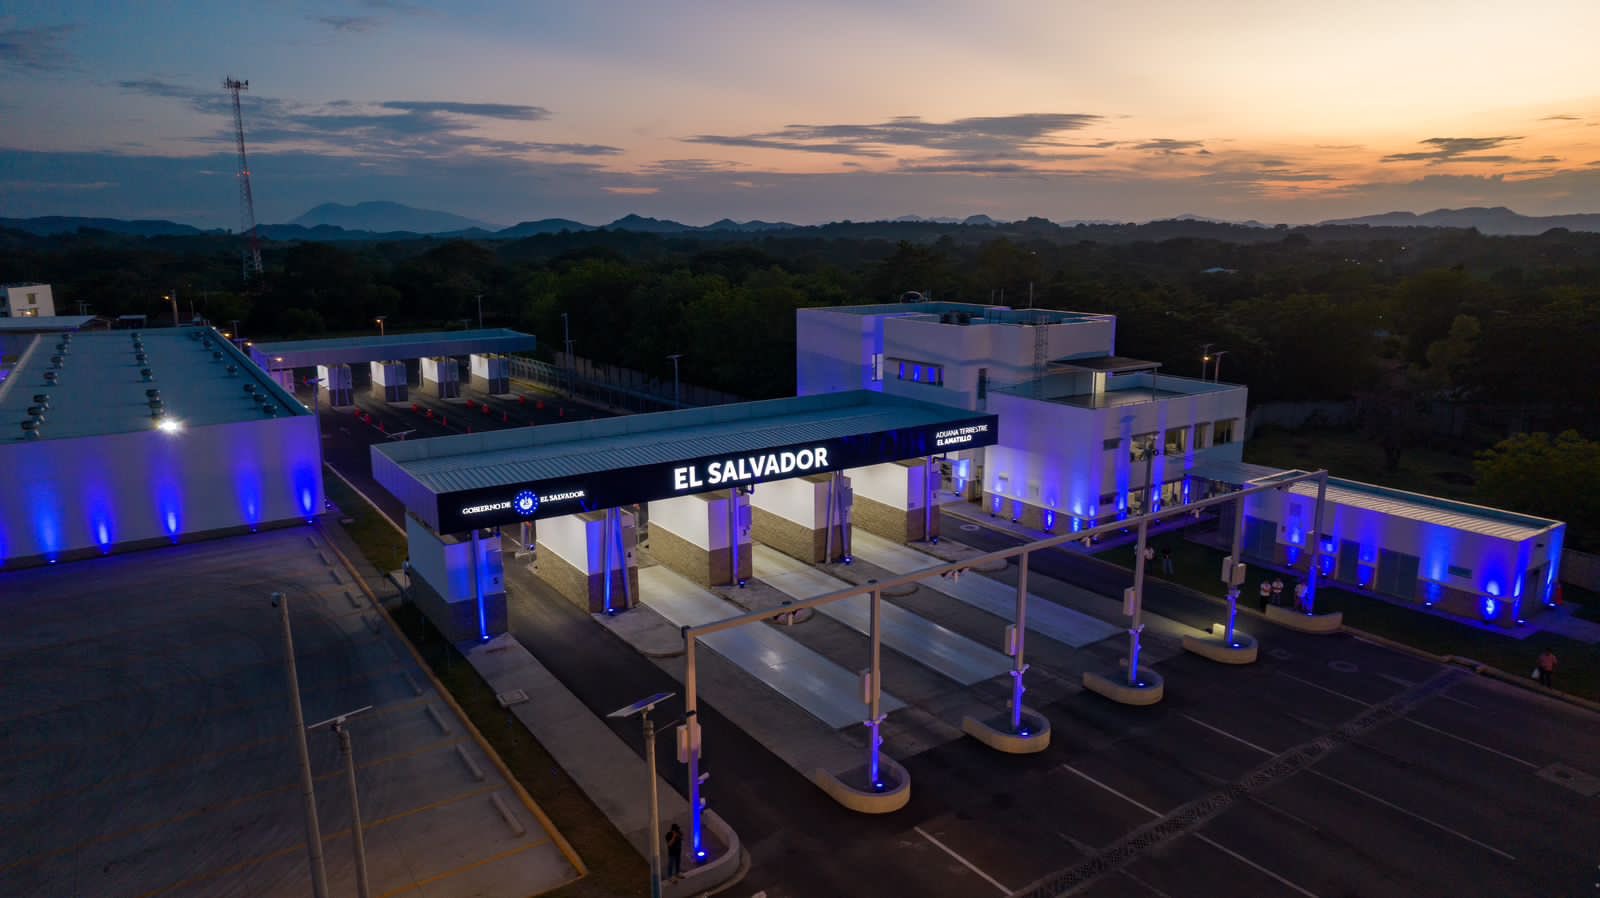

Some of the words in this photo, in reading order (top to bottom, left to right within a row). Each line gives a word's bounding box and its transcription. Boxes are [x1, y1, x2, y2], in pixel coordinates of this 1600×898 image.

[936, 429, 959, 439] ADUANA
[960, 424, 988, 434] TERRESTRE
[944, 434, 972, 445] AMATILLO
[674, 466, 702, 490] EL
[707, 447, 829, 484] SALVADOR
[462, 503, 500, 515] GOBIERNO
[549, 490, 585, 502] SALVADOR
